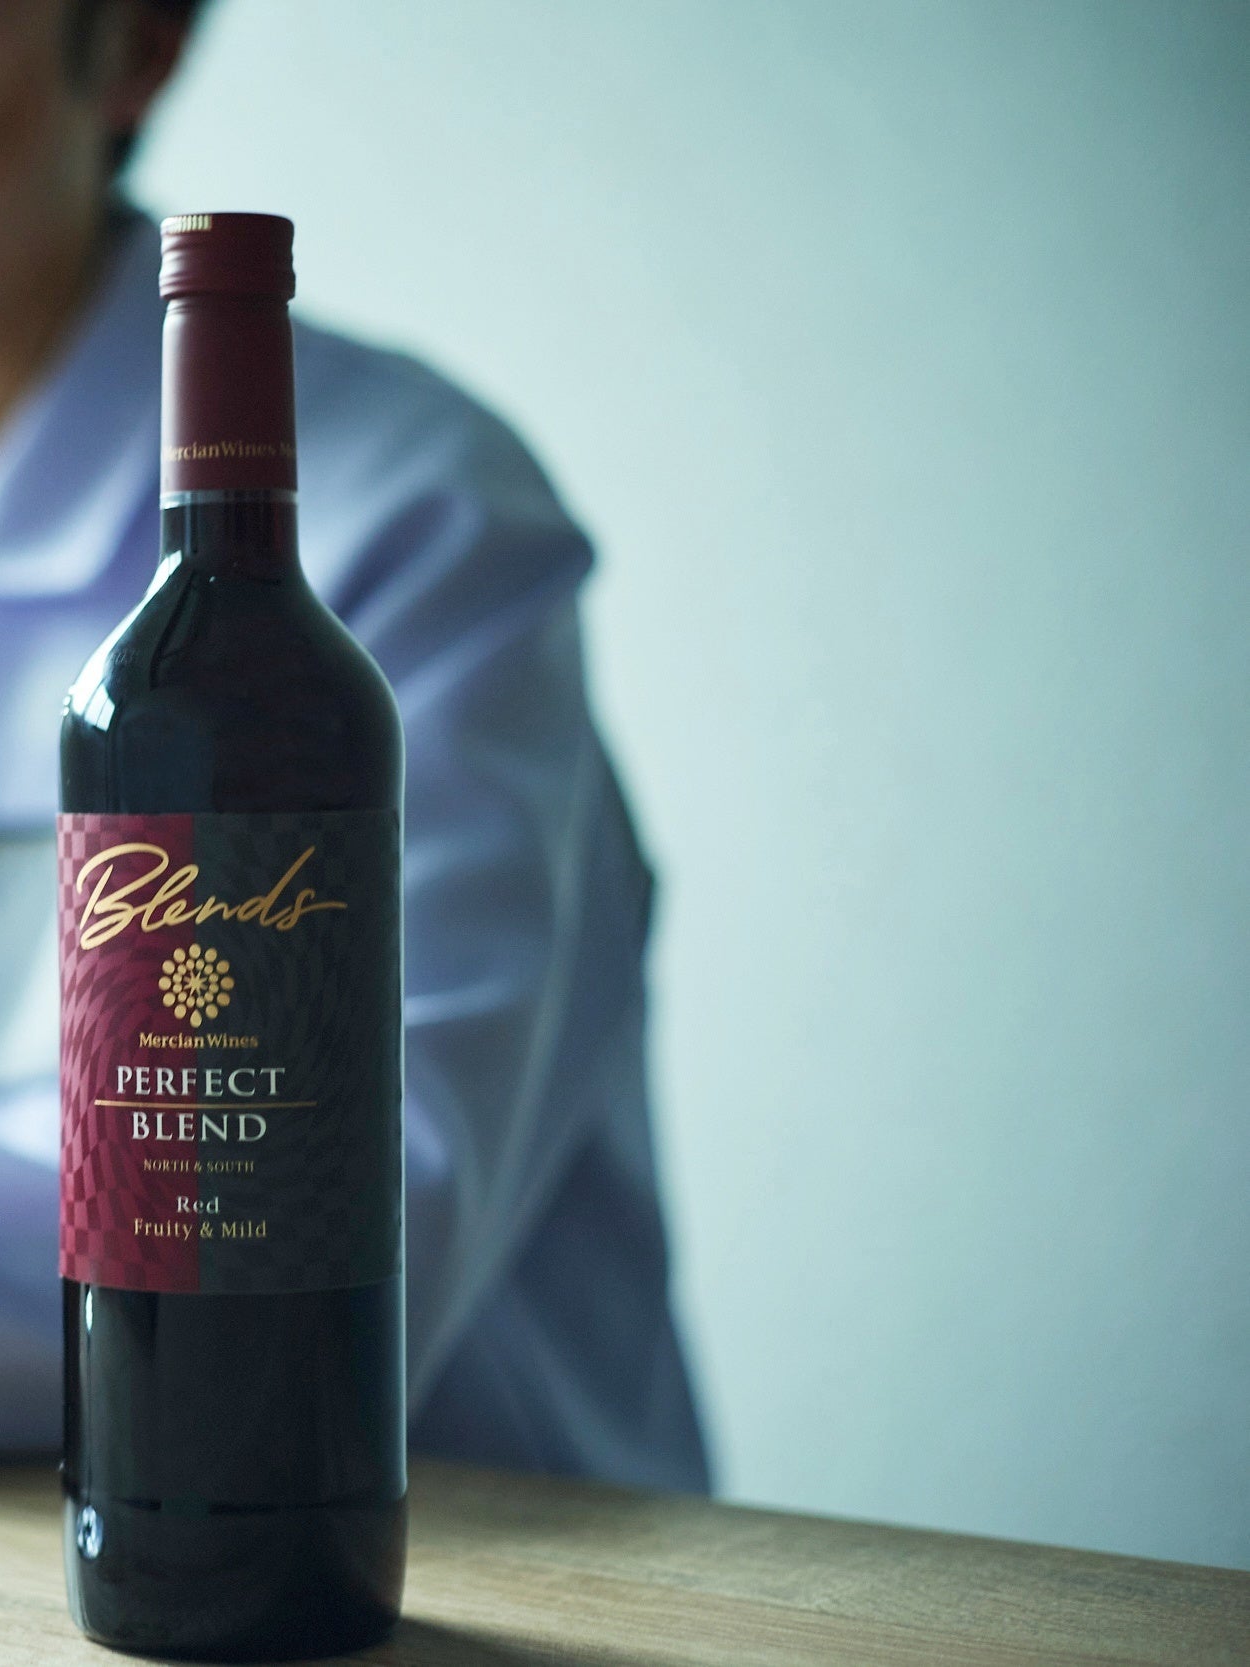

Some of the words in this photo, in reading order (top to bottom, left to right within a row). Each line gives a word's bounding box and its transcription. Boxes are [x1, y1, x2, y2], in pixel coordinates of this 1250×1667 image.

[76, 842, 348, 950] Blends
[116, 1065, 286, 1097] PERFECT
[132, 1111, 267, 1143] BLEND
[143, 1158, 190, 1173] NORTH
[206, 1160, 255, 1173] SOUTH
[177, 1195, 220, 1214] Red
[134, 1217, 193, 1240] Fruity
[199, 1220, 214, 1238] &
[221, 1219, 267, 1238] Mild
